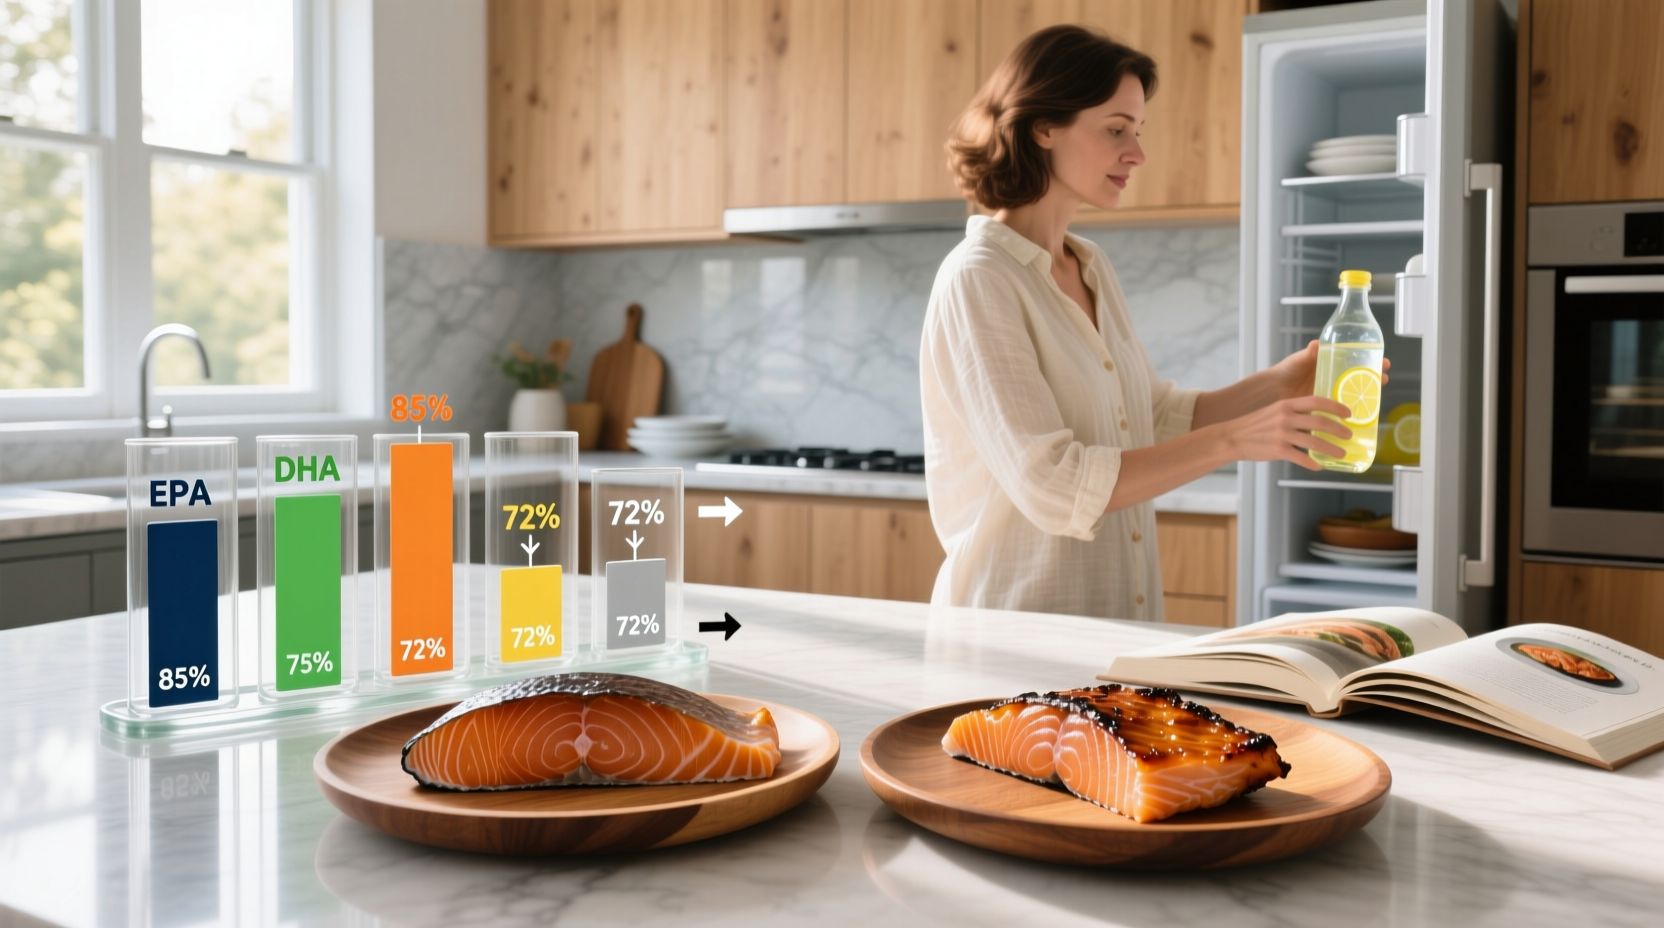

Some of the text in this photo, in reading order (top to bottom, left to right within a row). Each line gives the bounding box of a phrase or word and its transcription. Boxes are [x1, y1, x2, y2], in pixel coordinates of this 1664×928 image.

[390, 394, 453, 422] 85%
[274, 455, 341, 483] DHA
[150, 479, 212, 507] EPA
[502, 503, 561, 530] 72%
[608, 499, 665, 525] 72%
[511, 625, 556, 649] 72%
[616, 614, 660, 636] 72%
[400, 637, 446, 661] 72%
[286, 651, 333, 675] 75%
[158, 664, 211, 690] 85%
